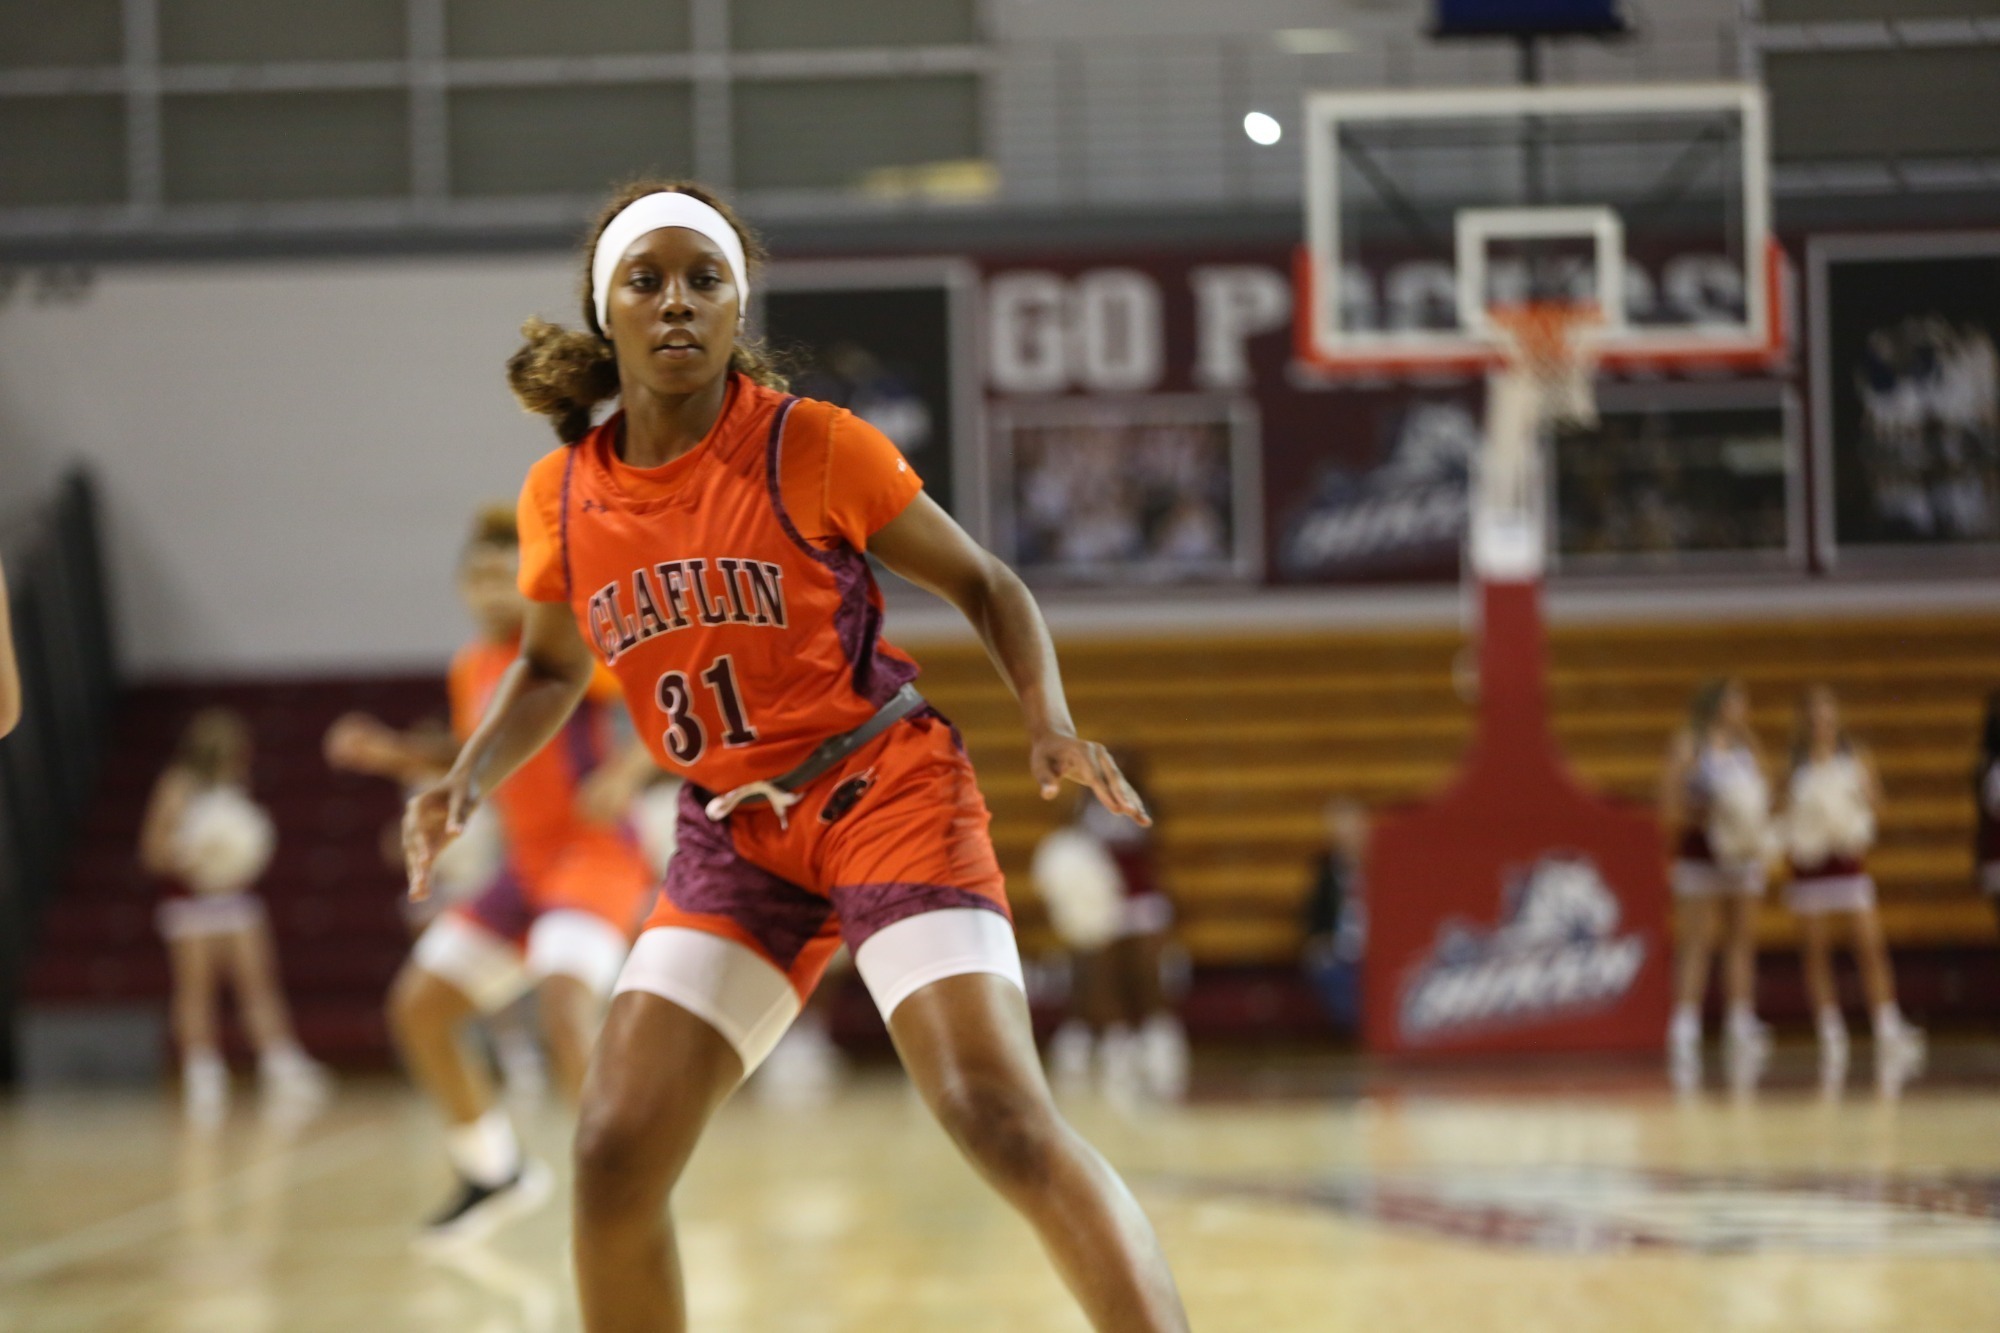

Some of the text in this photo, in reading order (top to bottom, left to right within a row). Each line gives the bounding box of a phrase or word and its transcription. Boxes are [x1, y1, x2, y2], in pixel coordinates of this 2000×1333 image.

[988, 267, 1165, 391] GO
[588, 557, 789, 667] CLAFLIN
[655, 653, 759, 767] 31
